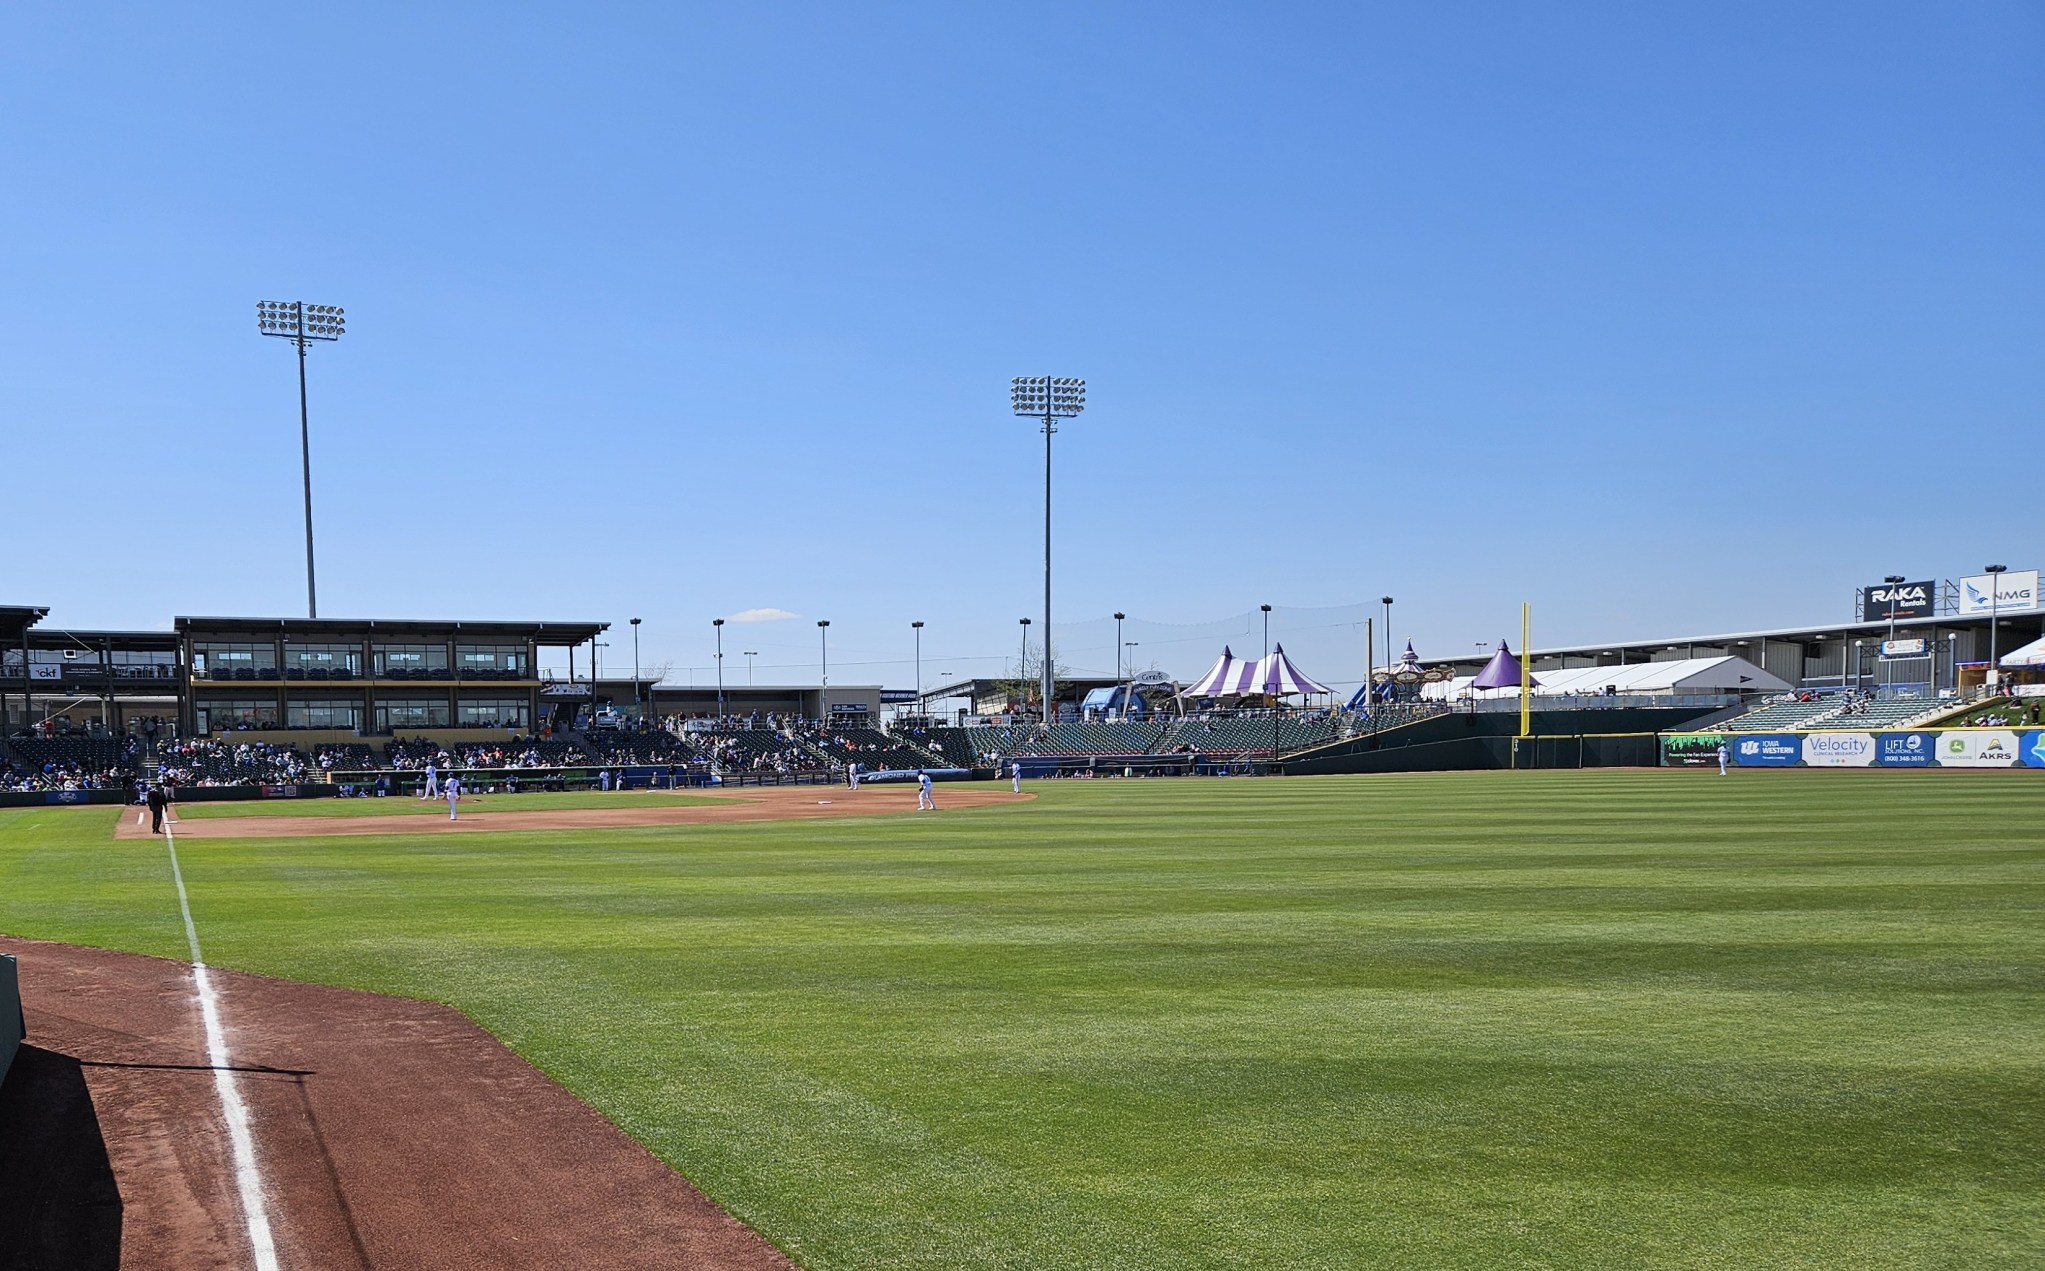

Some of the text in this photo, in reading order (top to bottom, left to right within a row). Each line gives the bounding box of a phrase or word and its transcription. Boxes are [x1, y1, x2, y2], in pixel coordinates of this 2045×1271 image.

[1871, 586, 1926, 603] RAKA
[1993, 589, 2030, 601] NMG
[1900, 599, 1926, 608] Rentals
[1141, 672, 1163, 681] Centris
[1762, 740, 1779, 748] IOWA
[1810, 737, 1867, 755] Velocity
[1885, 739, 1904, 750] LIFT
[1762, 746, 1794, 754] WESTERN
[1979, 752, 2012, 760] AKRS
[868, 772, 904, 781] DIAMOND
